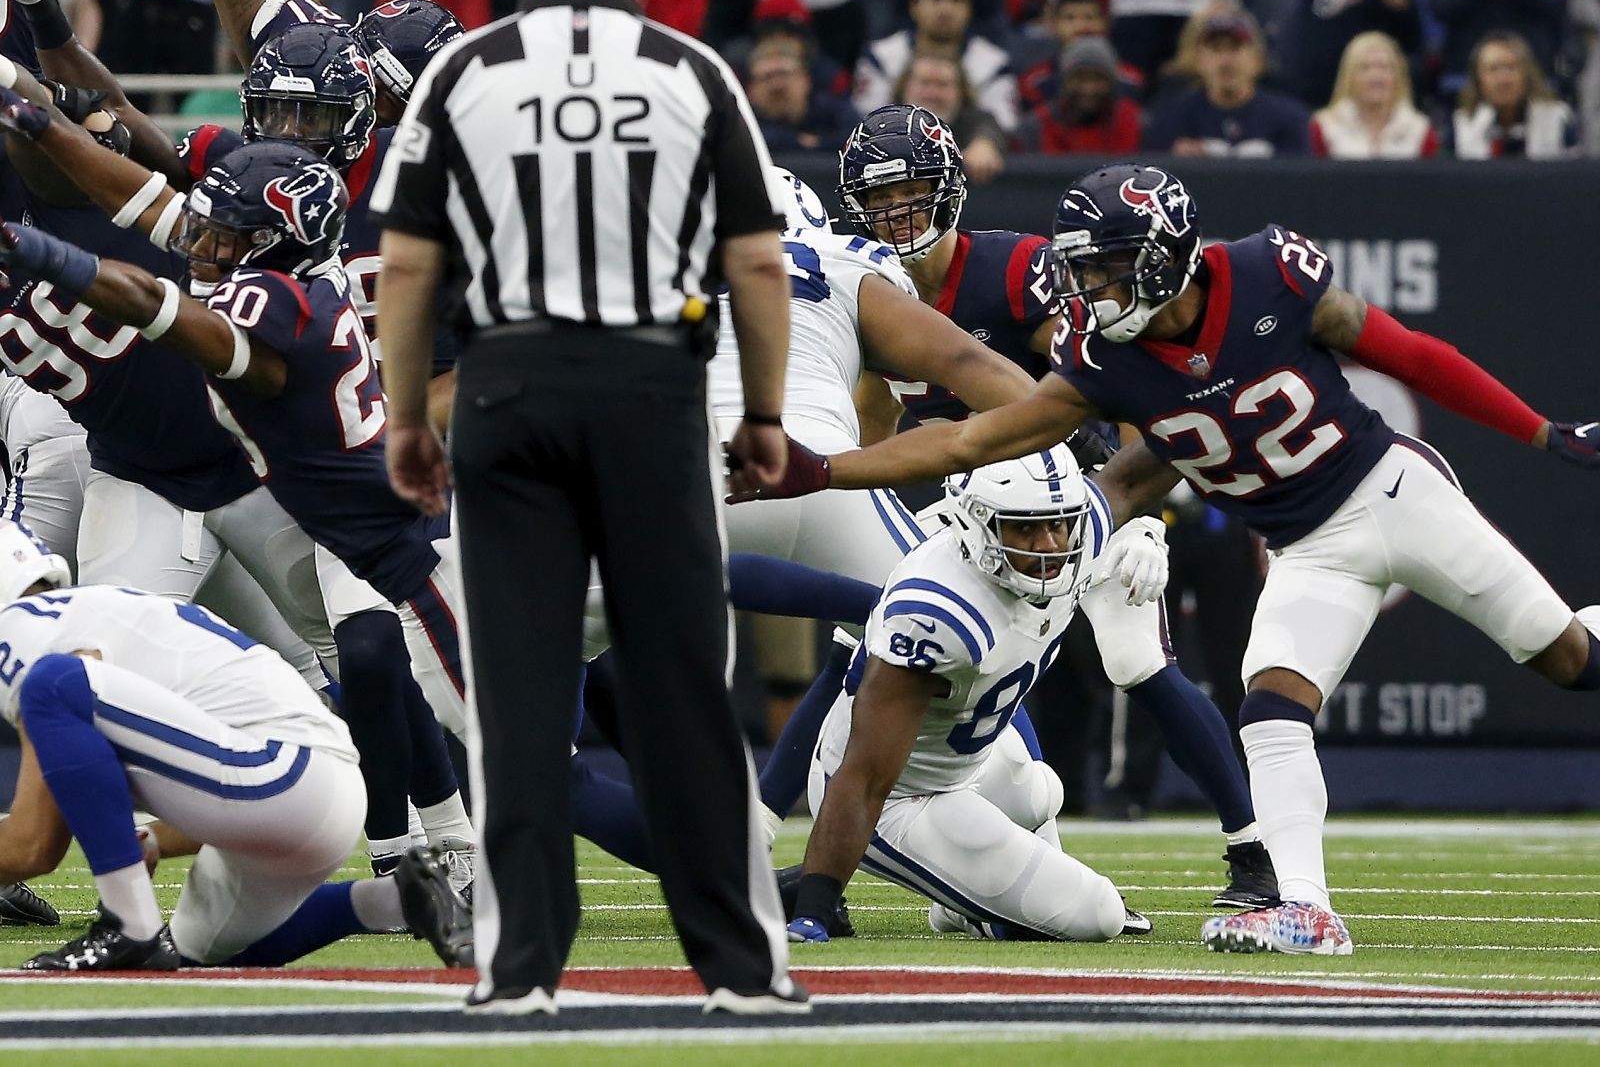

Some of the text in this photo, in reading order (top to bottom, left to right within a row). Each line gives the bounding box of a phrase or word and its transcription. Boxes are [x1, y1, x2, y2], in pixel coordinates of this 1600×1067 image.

[567, 62, 595, 88] U
[519, 95, 651, 146] 102
[10, 279, 34, 309] EXANS
[206, 282, 268, 328] 20
[331, 308, 390, 451] 2
[1185, 378, 1234, 401] TEXANS
[1151, 370, 1344, 495] 22
[1376, 684, 1485, 735] STOP
